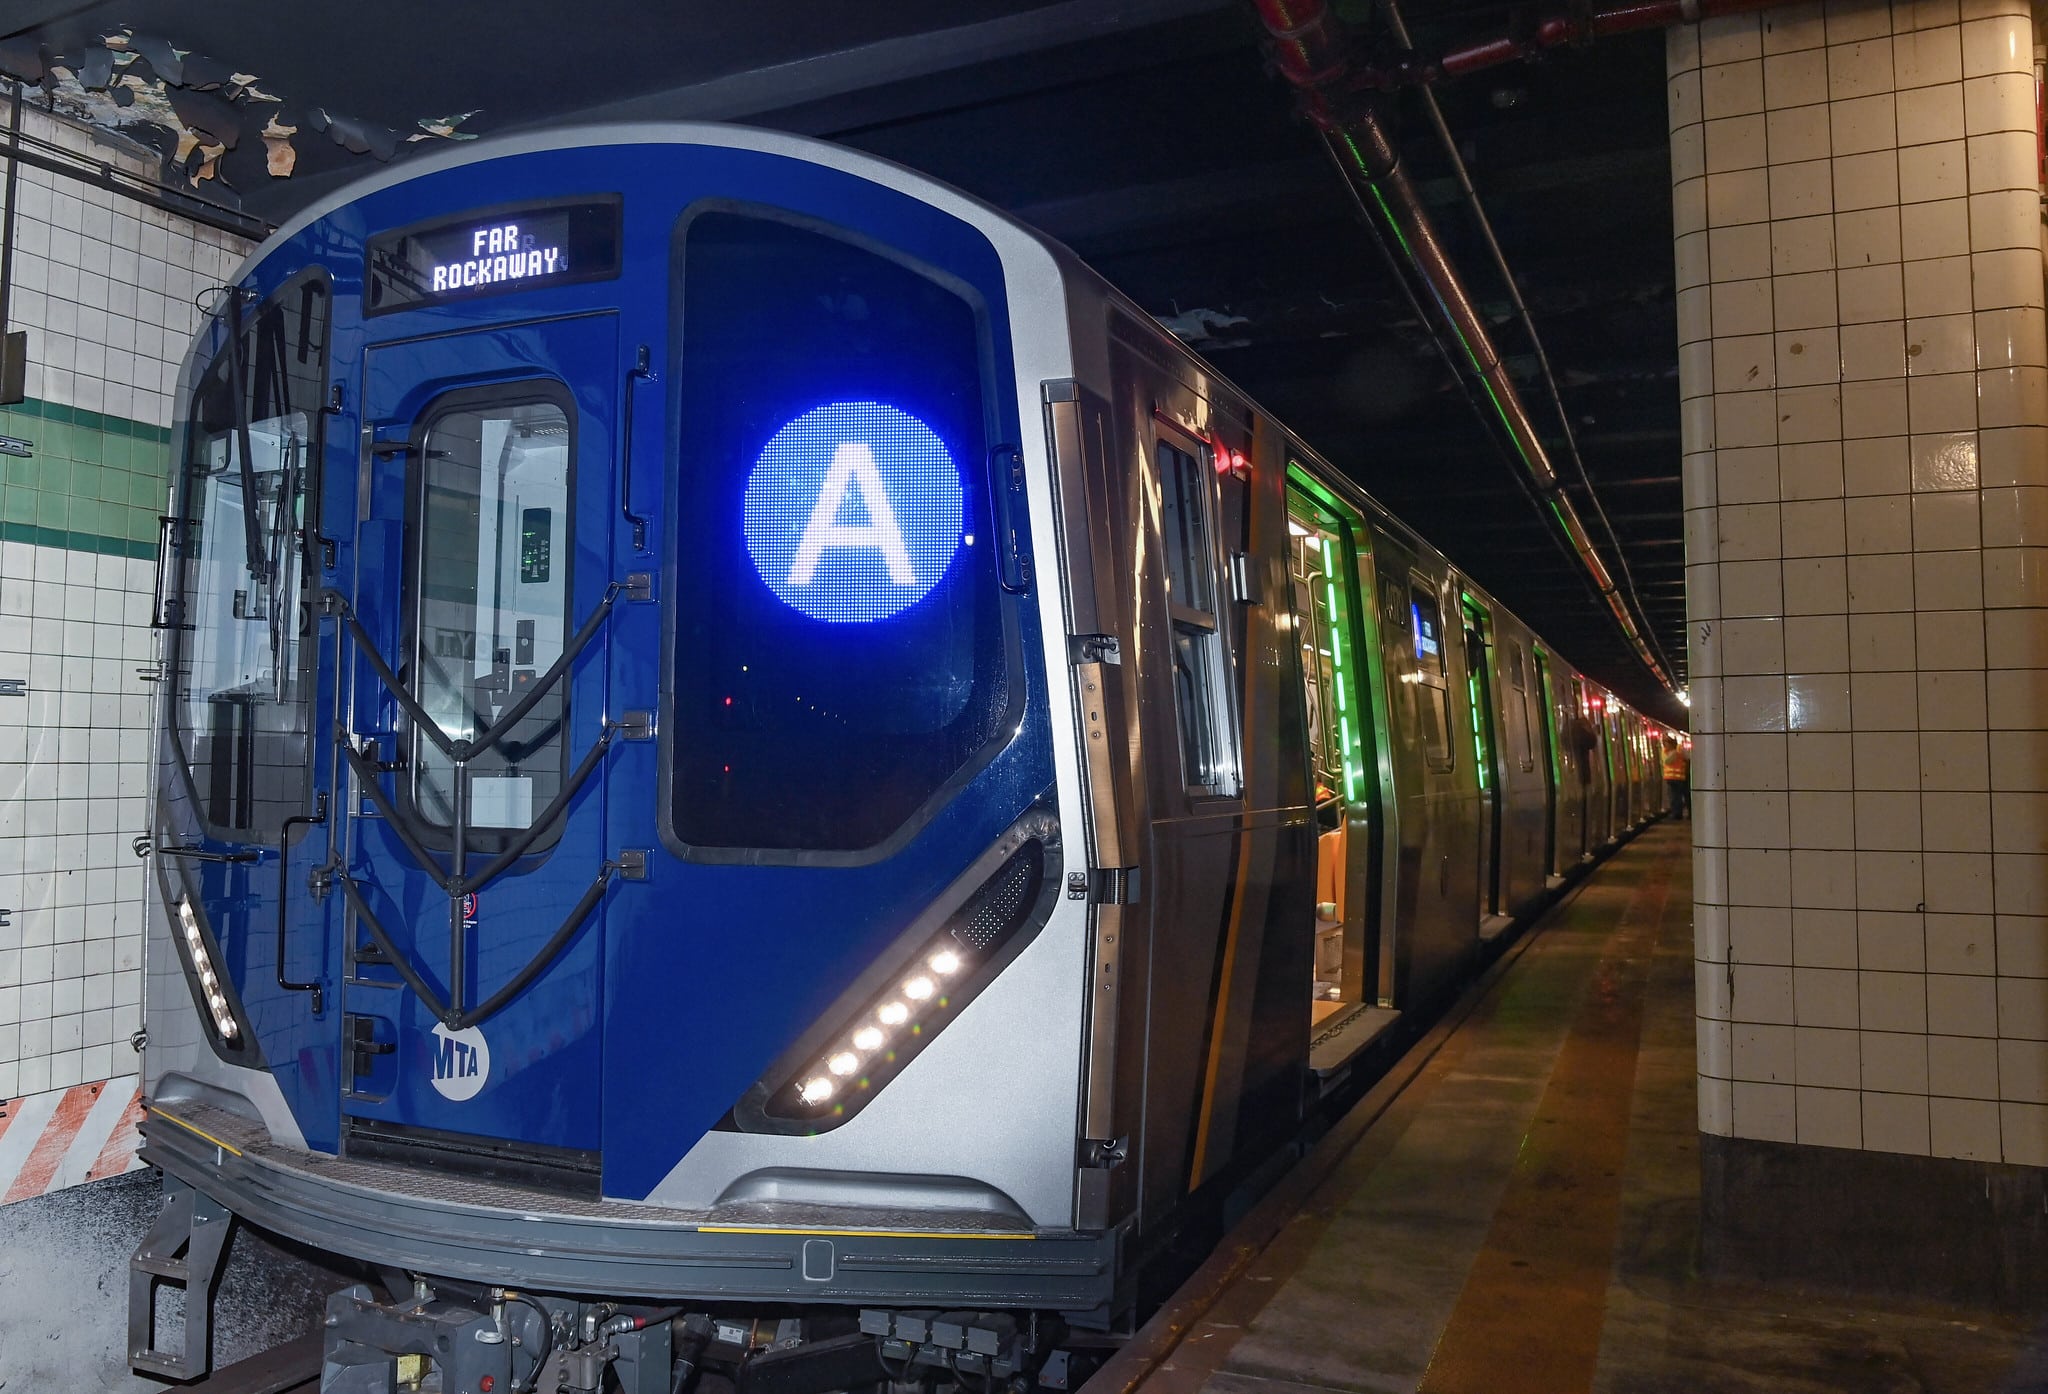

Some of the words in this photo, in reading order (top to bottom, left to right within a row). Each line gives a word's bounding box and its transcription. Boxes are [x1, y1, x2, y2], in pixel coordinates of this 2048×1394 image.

[474, 225, 518, 256] FAR
[433, 247, 558, 291] ROCKAWAY
[787, 442, 916, 584] A
[433, 1034, 478, 1080] MTA
